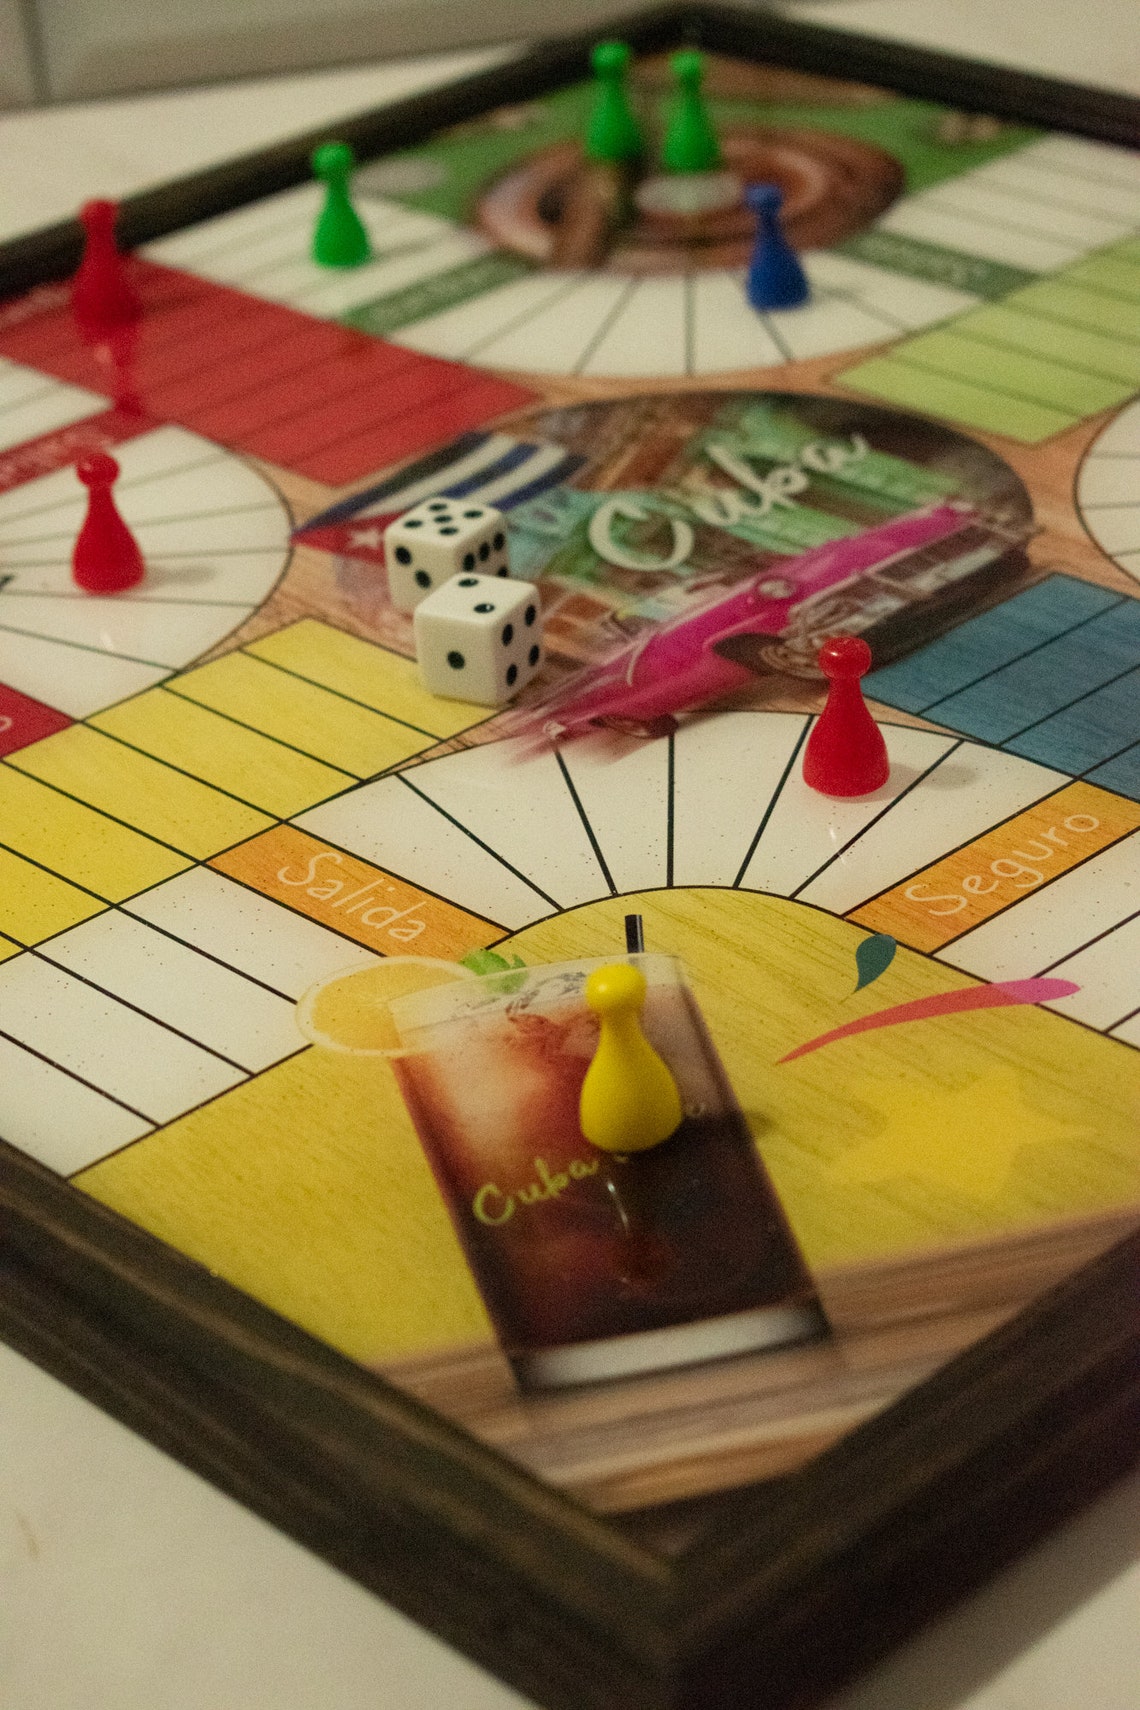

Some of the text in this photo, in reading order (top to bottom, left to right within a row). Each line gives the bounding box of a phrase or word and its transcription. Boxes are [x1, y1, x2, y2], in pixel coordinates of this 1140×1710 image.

[588, 433, 869, 571] Cuba
[276, 852, 427, 942] Salida
[904, 813, 1100, 917] Seguro
[472, 1156, 598, 1226] Cuba
